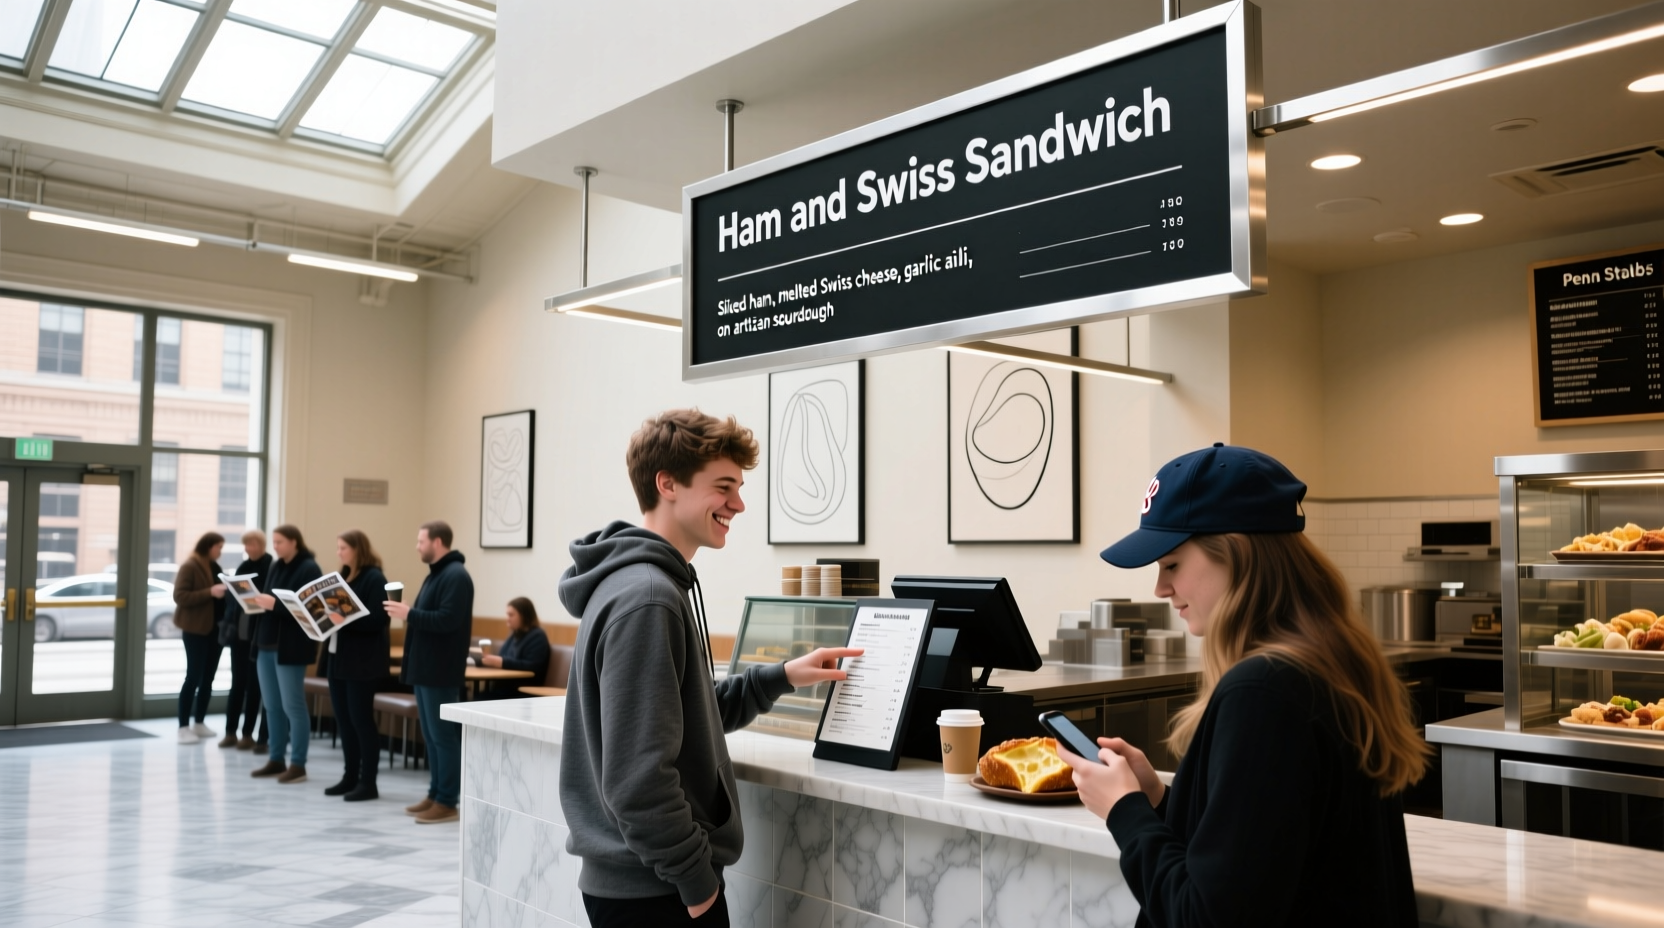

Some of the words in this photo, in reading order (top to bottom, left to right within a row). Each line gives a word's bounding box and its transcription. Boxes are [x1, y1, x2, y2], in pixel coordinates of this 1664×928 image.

[718, 208, 782, 253] Ham
[790, 177, 847, 233] and
[856, 155, 956, 214] Swiss
[965, 85, 1171, 184] Sandwich
[820, 274, 853, 295] Swiss
[855, 268, 902, 288] cheese,
[903, 253, 942, 283] garlic
[1562, 272, 1601, 287] Penn
[717, 324, 731, 338] on
